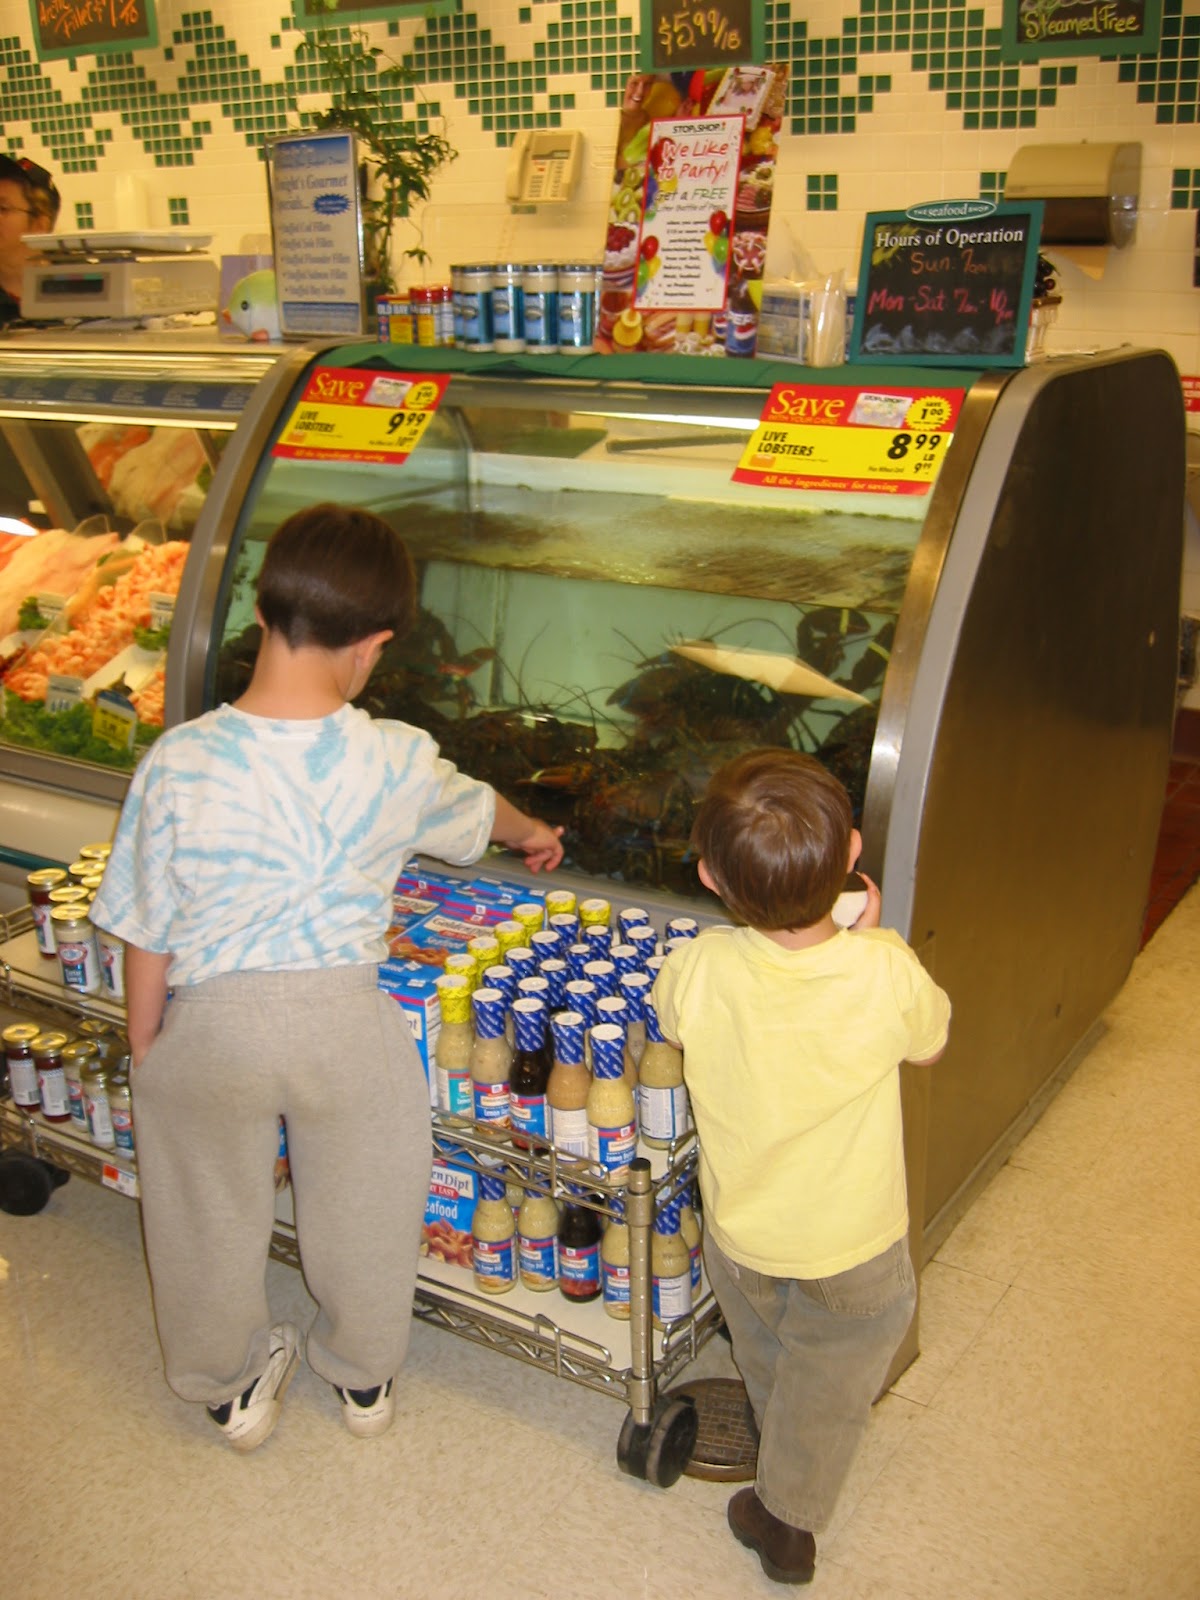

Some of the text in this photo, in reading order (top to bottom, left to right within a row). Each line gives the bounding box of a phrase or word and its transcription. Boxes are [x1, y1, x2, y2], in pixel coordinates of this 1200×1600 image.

[1024, 4, 1140, 38] Steamed Free
[661, 139, 729, 159] We Like
[680, 160, 729, 184] Party!
[691, 187, 729, 200] FREE
[926, 203, 968, 217] seafood
[876, 228, 1024, 249] Hours of Operation
[309, 373, 365, 399] Save
[771, 390, 845, 418] Save
[300, 411, 319, 421] LIVE
[294, 421, 336, 433] LOBSTERS
[762, 431, 789, 442] LIVE
[757, 442, 815, 456] LOBSTERS
[762, 475, 899, 493] All the ingredients for saving
